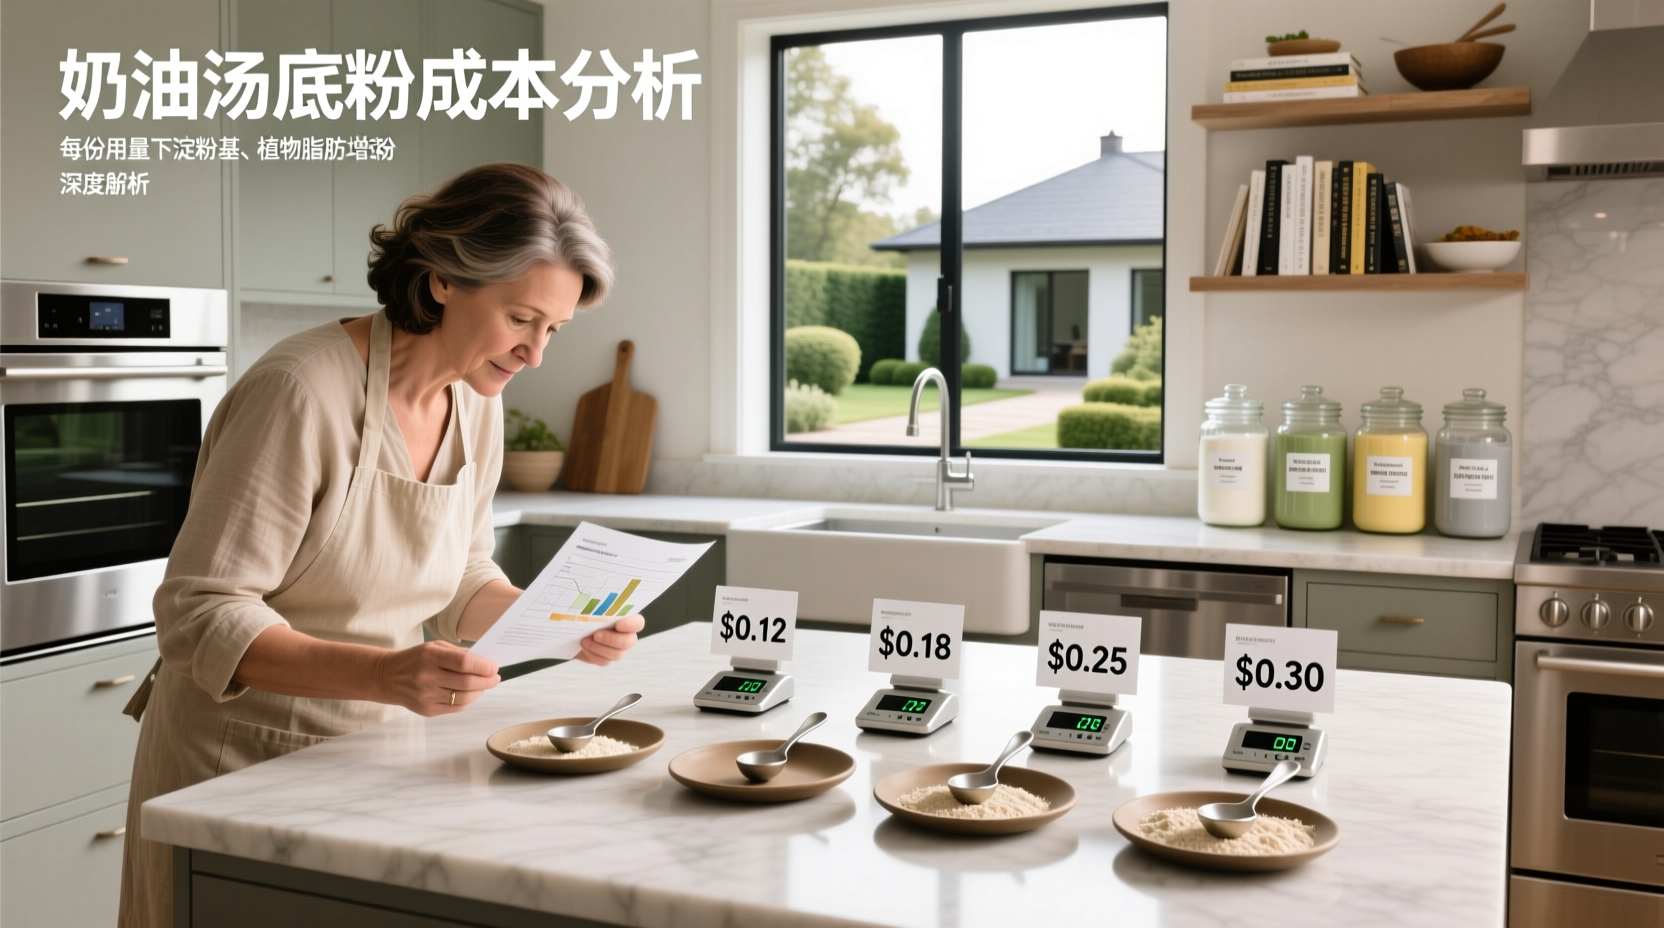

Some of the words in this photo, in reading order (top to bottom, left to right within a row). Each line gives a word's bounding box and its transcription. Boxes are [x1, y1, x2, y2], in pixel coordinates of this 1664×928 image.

[719, 610, 788, 644] $0.12
[878, 625, 952, 661] $0.18
[1047, 638, 1128, 675] $0.25
[1235, 653, 1325, 692] $0.30
